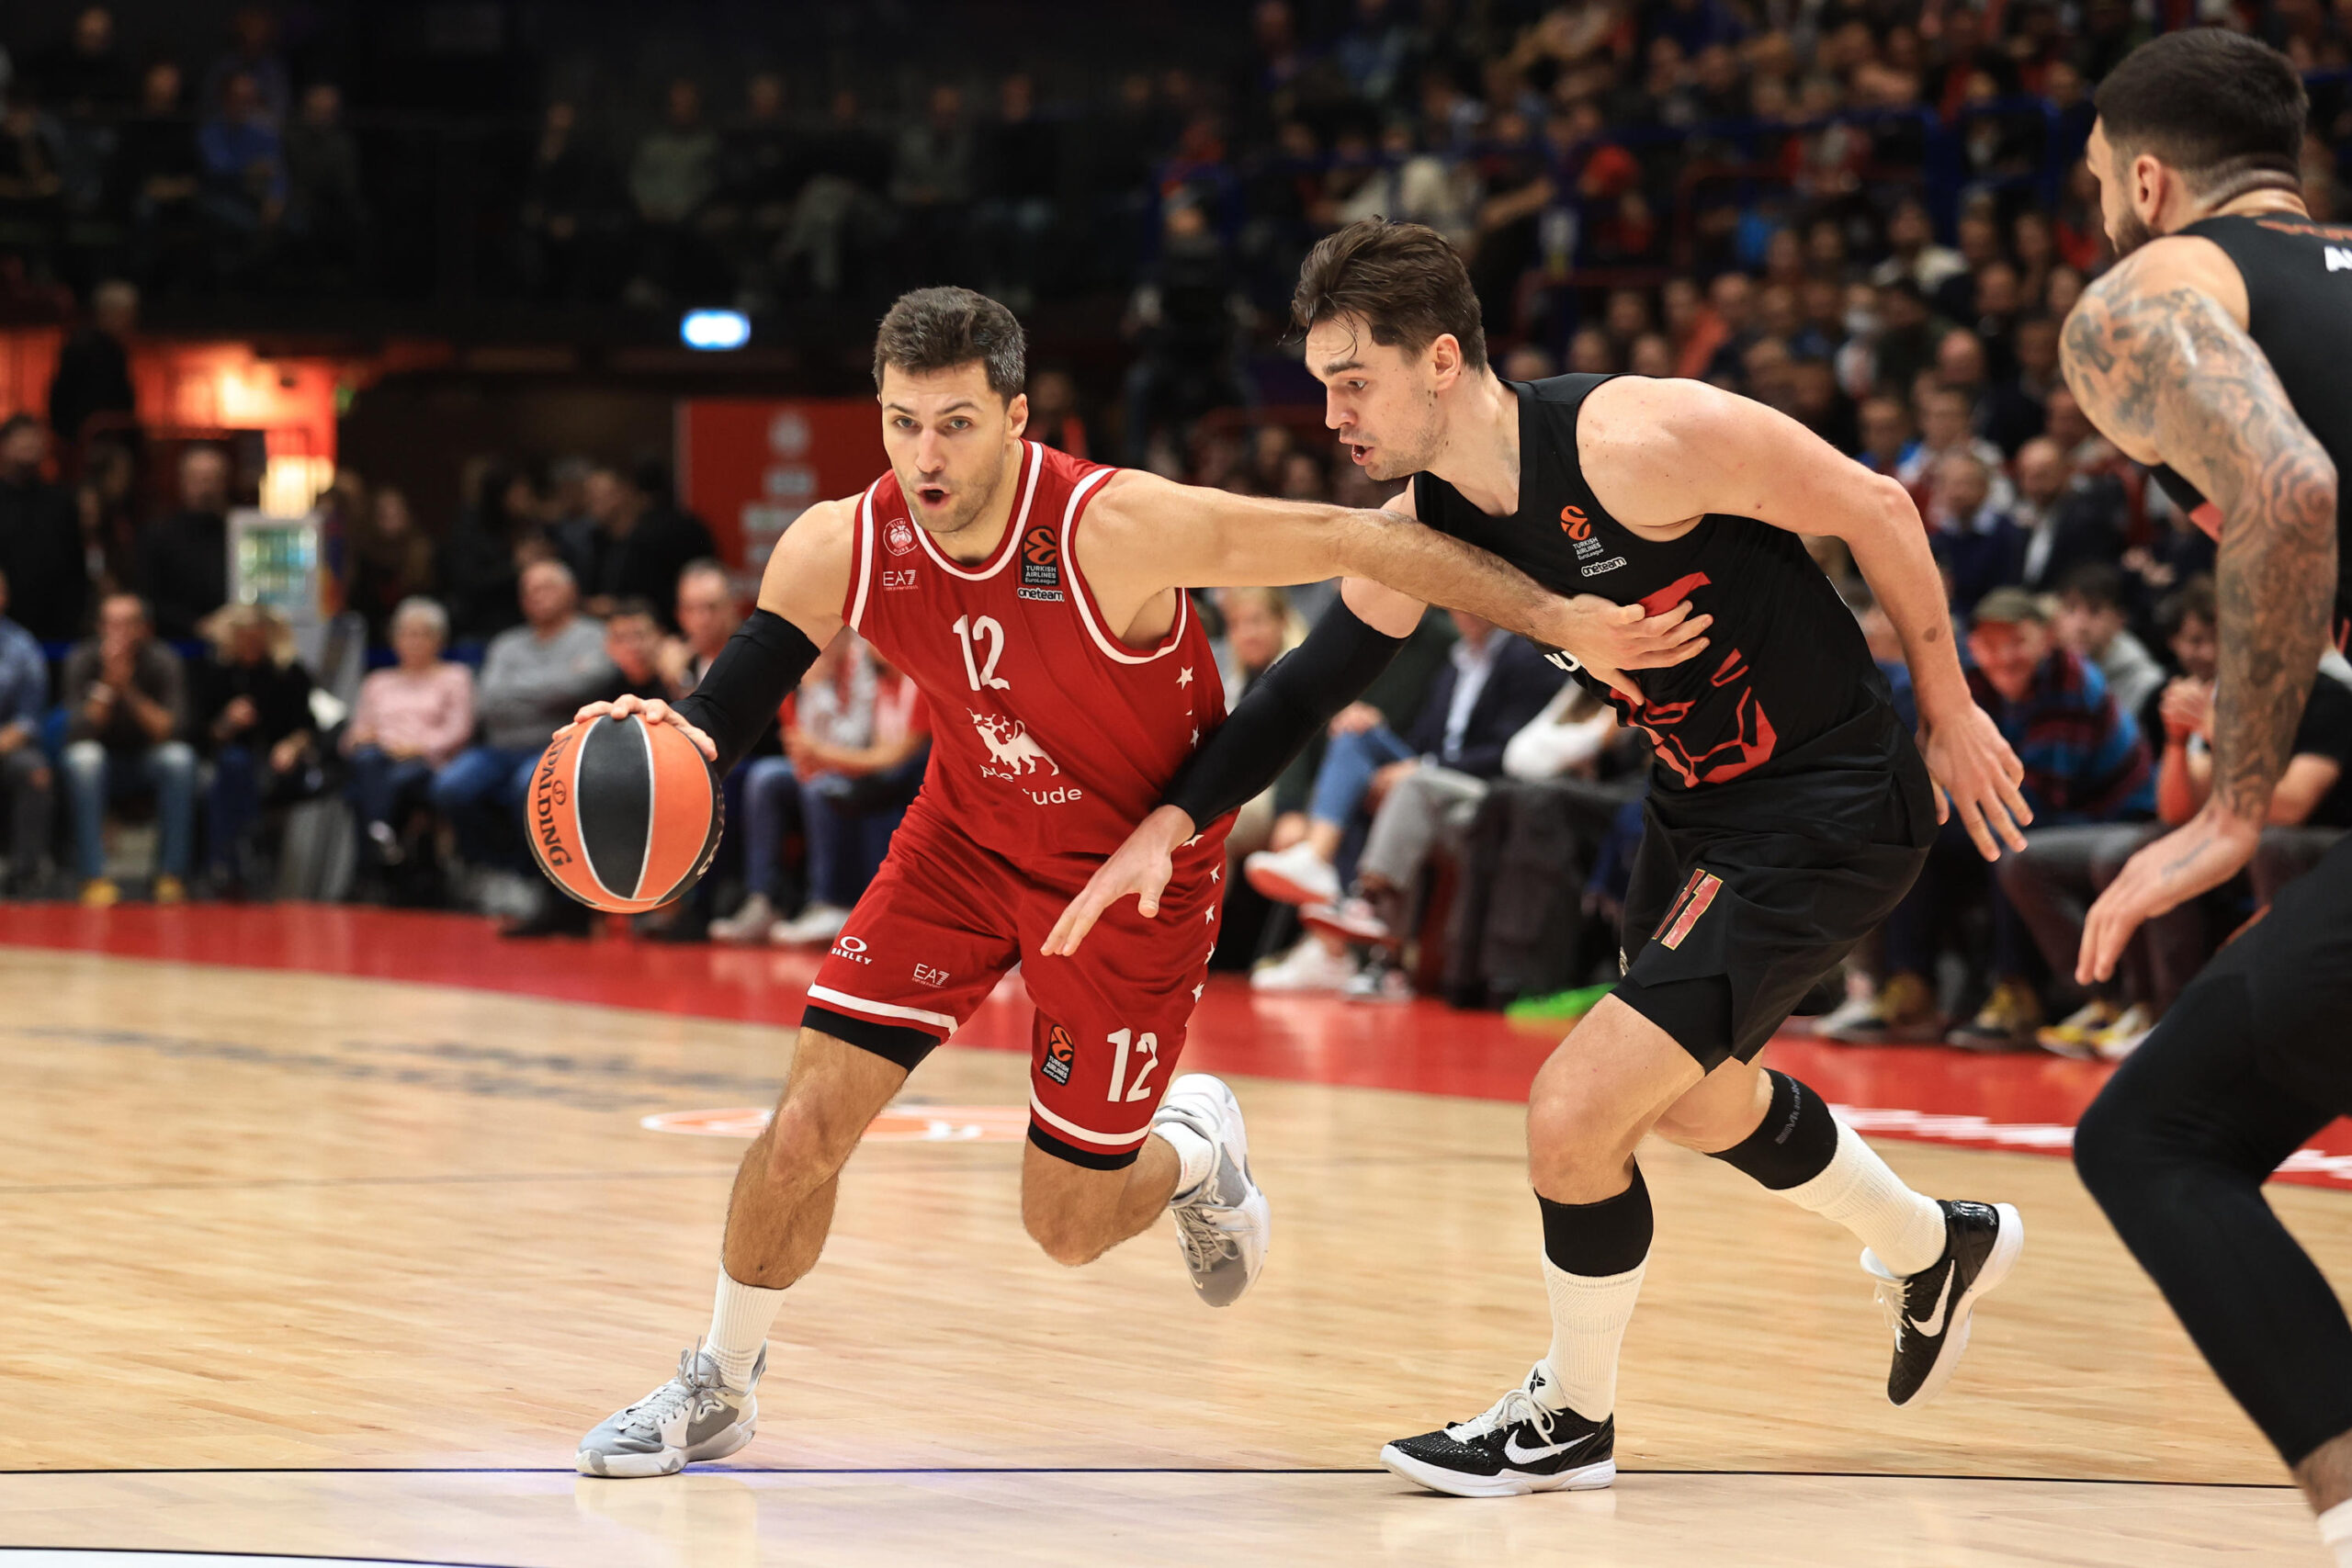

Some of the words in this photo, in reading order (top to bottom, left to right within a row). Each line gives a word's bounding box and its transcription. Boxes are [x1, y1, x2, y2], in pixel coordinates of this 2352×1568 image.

[1572, 536, 1599, 549] TURKISH
[1576, 543, 1601, 556] AIRLINES
[1025, 565, 1057, 573] TURKISH
[1581, 557, 1627, 577] oneteam
[883, 570, 917, 586] EA7
[1017, 588, 1065, 602] oneteam
[953, 614, 1011, 691] 12
[1651, 868, 1724, 951] 11
[913, 963, 950, 986] EA7
[1106, 1027, 1159, 1102] 12
